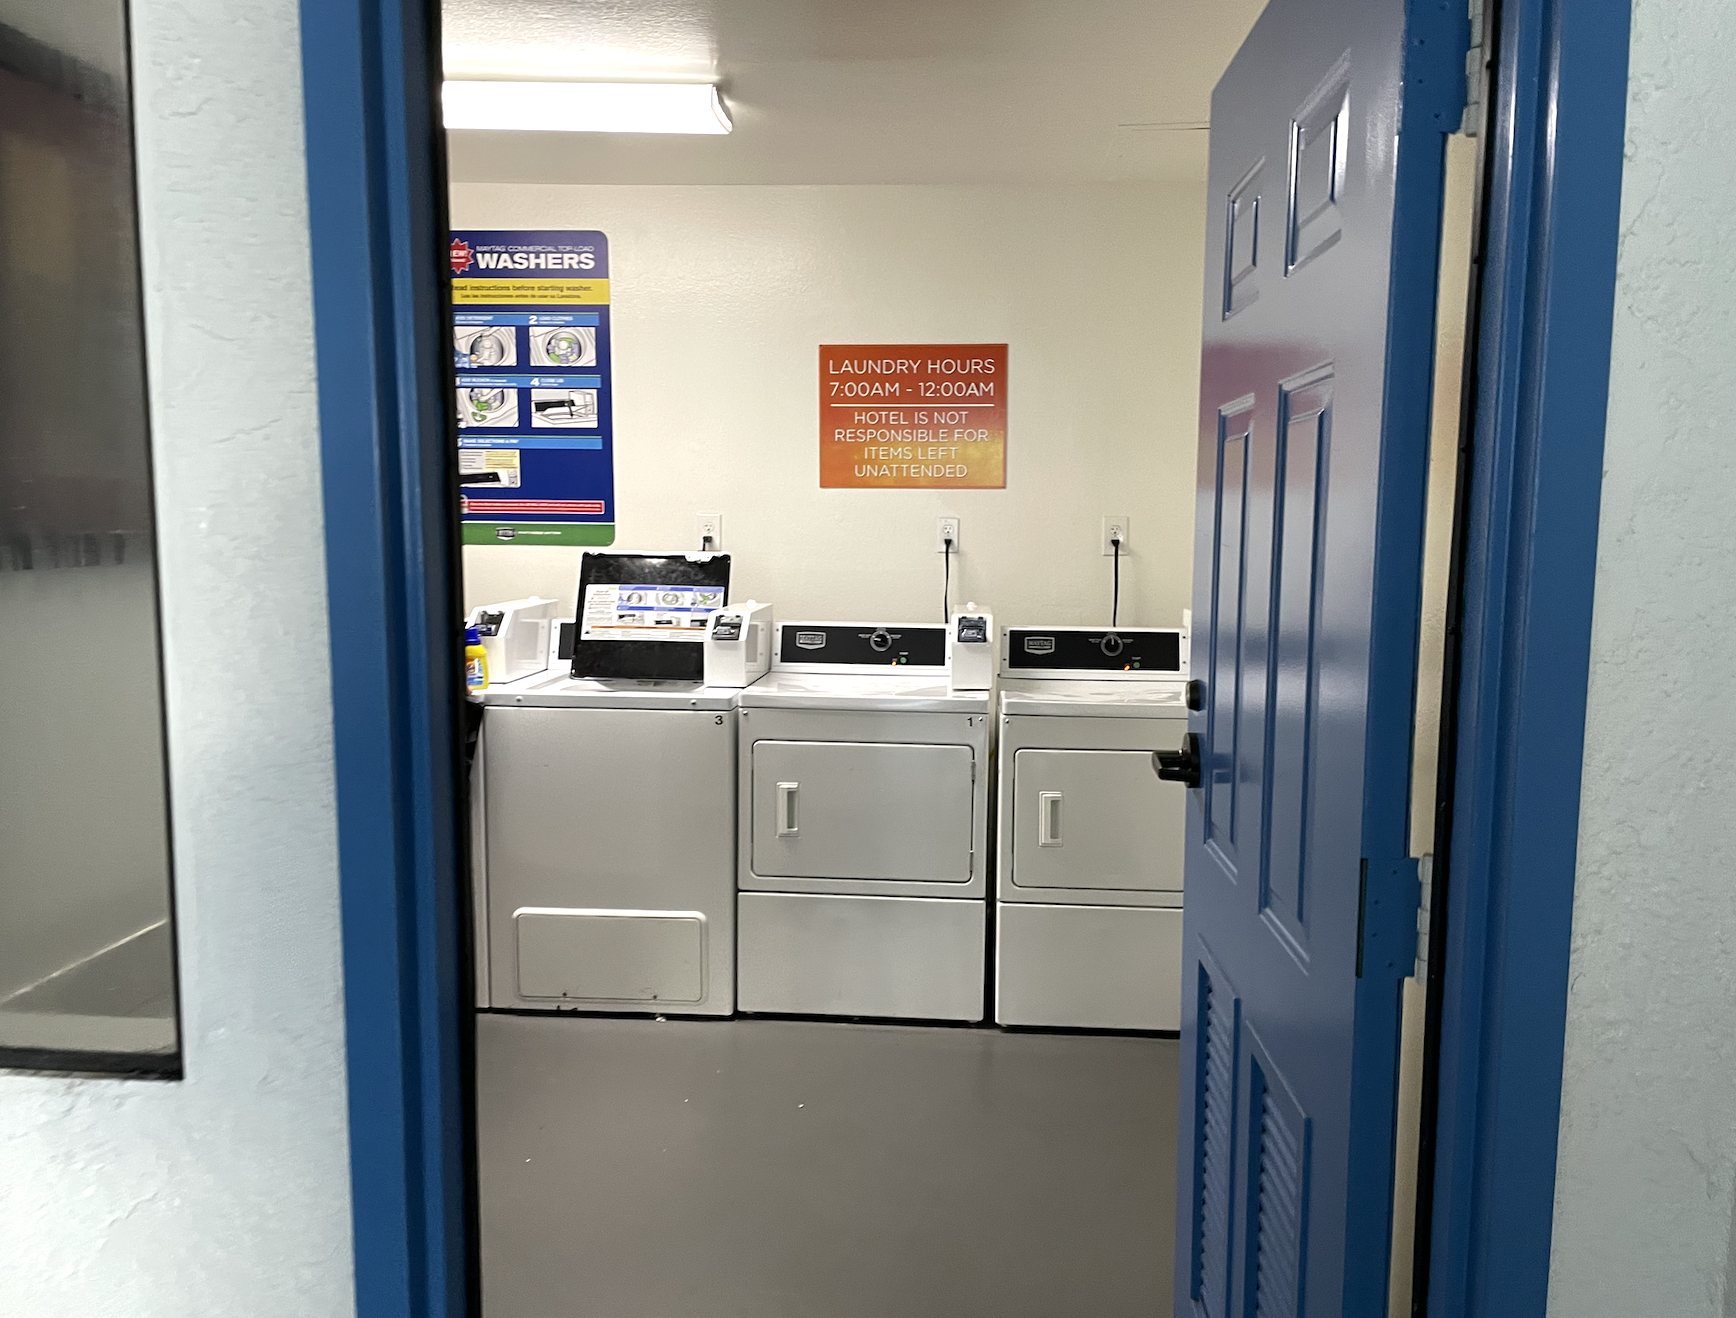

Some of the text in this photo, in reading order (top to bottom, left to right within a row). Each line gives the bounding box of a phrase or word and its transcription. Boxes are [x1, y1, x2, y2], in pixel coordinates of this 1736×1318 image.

[476, 252, 596, 270] WASHERS
[537, 285, 564, 293] starting
[529, 315, 538, 325] 2
[829, 358, 996, 374] LAUNDRY HOURS
[530, 377, 540, 387] 4
[829, 381, 900, 397] 7:00AM
[918, 381, 995, 397] 12:00AM
[854, 411, 969, 425] HOTEL IS NOT
[834, 429, 989, 442] RESPONSIBLE FOR
[864, 447, 958, 460] ITEMS LEFT
[854, 464, 968, 478] UNATTENDED
[715, 715, 724, 726] 3
[967, 716, 973, 727] 1
